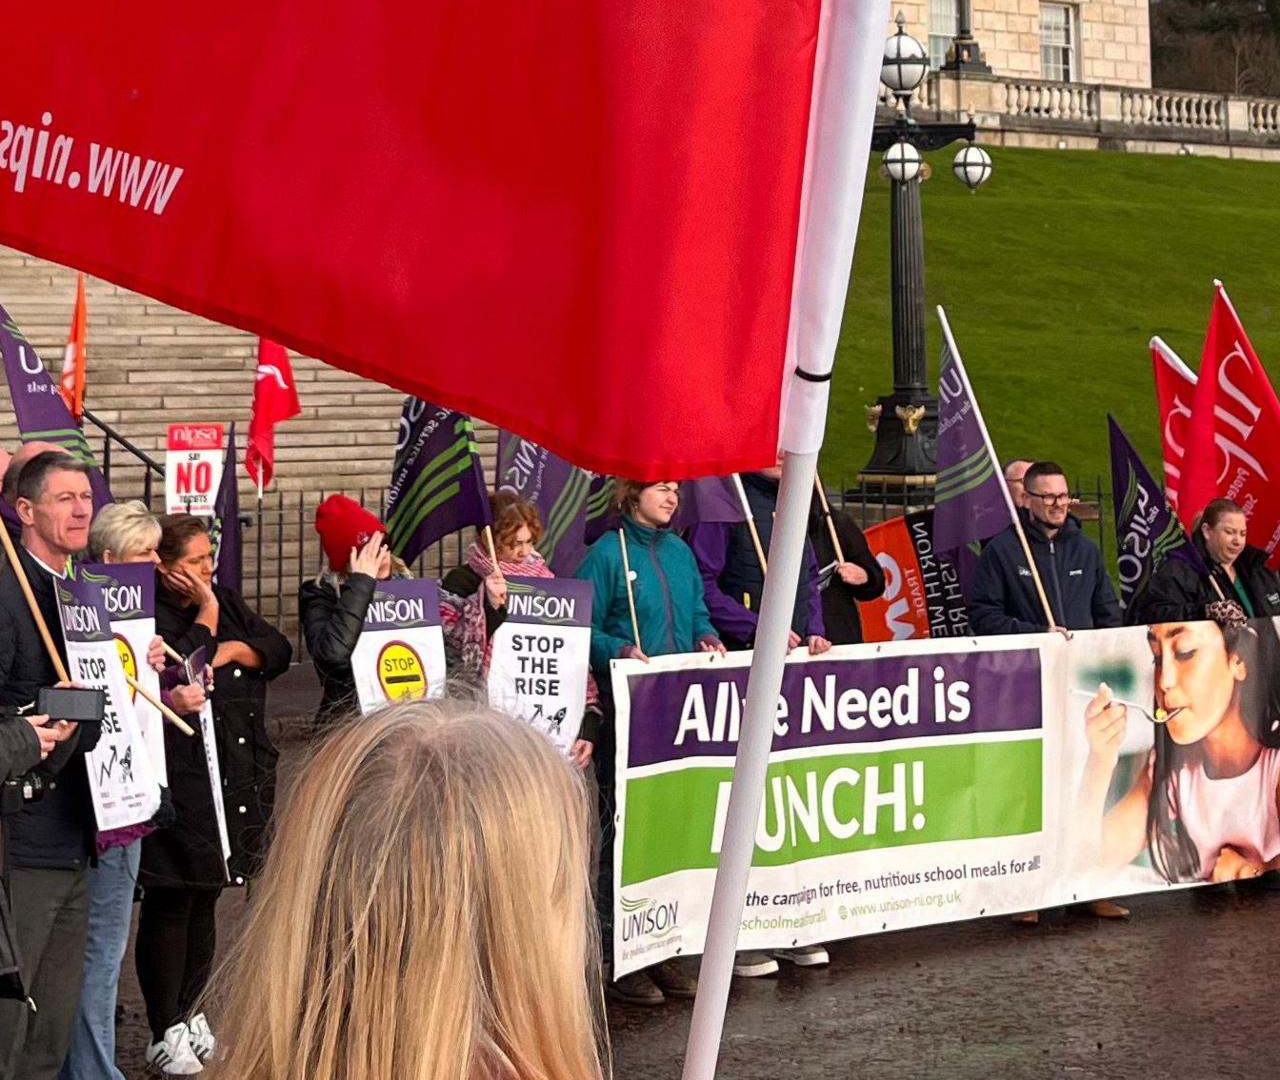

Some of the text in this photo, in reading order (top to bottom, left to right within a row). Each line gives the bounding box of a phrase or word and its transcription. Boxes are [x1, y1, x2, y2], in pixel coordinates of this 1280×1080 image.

[176, 461, 213, 495] NO
[101, 585, 142, 613] ISON
[365, 598, 425, 623] NISON
[512, 634, 565, 654] STOP
[79, 657, 106, 679] STOP
[384, 657, 415, 672] STOP
[517, 655, 558, 675] THE
[515, 677, 560, 697] RISE
[800, 666, 920, 734] Need
[933, 665, 971, 723] is
[746, 891, 769, 907] the
[772, 886, 817, 910] campaign
[819, 882, 834, 898] for
[836, 878, 862, 894] free,
[864, 870, 921, 892] nutritious
[924, 863, 967, 883] school
[970, 860, 1007, 879] meals
[1010, 859, 1027, 874] for
[622, 900, 679, 942] UNISON
